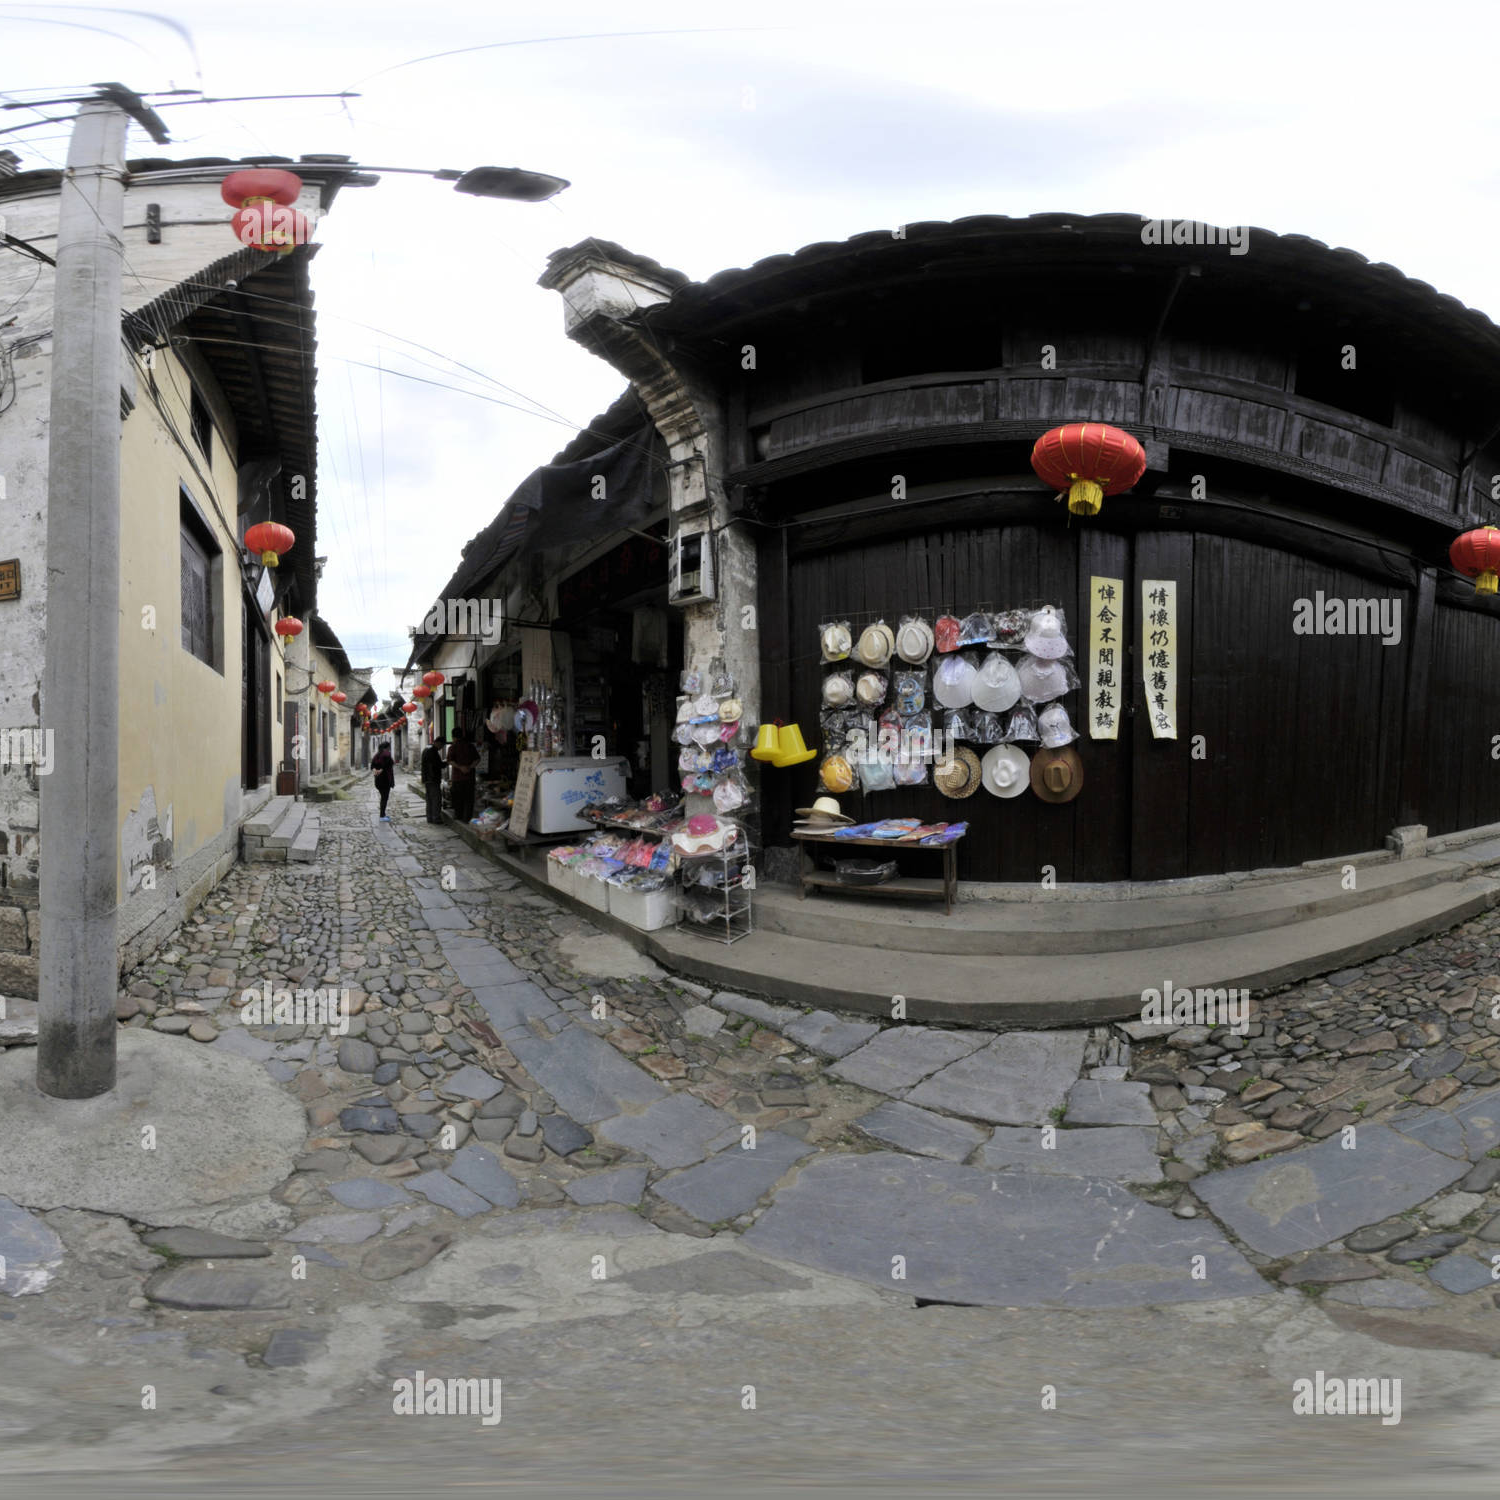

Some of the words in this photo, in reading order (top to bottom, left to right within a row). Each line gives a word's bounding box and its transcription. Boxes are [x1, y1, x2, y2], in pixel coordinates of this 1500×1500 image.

[1095, 583, 1117, 730] 悼念不聞親教誨
[1148, 587, 1172, 730] 情懷仍憶舊音容
